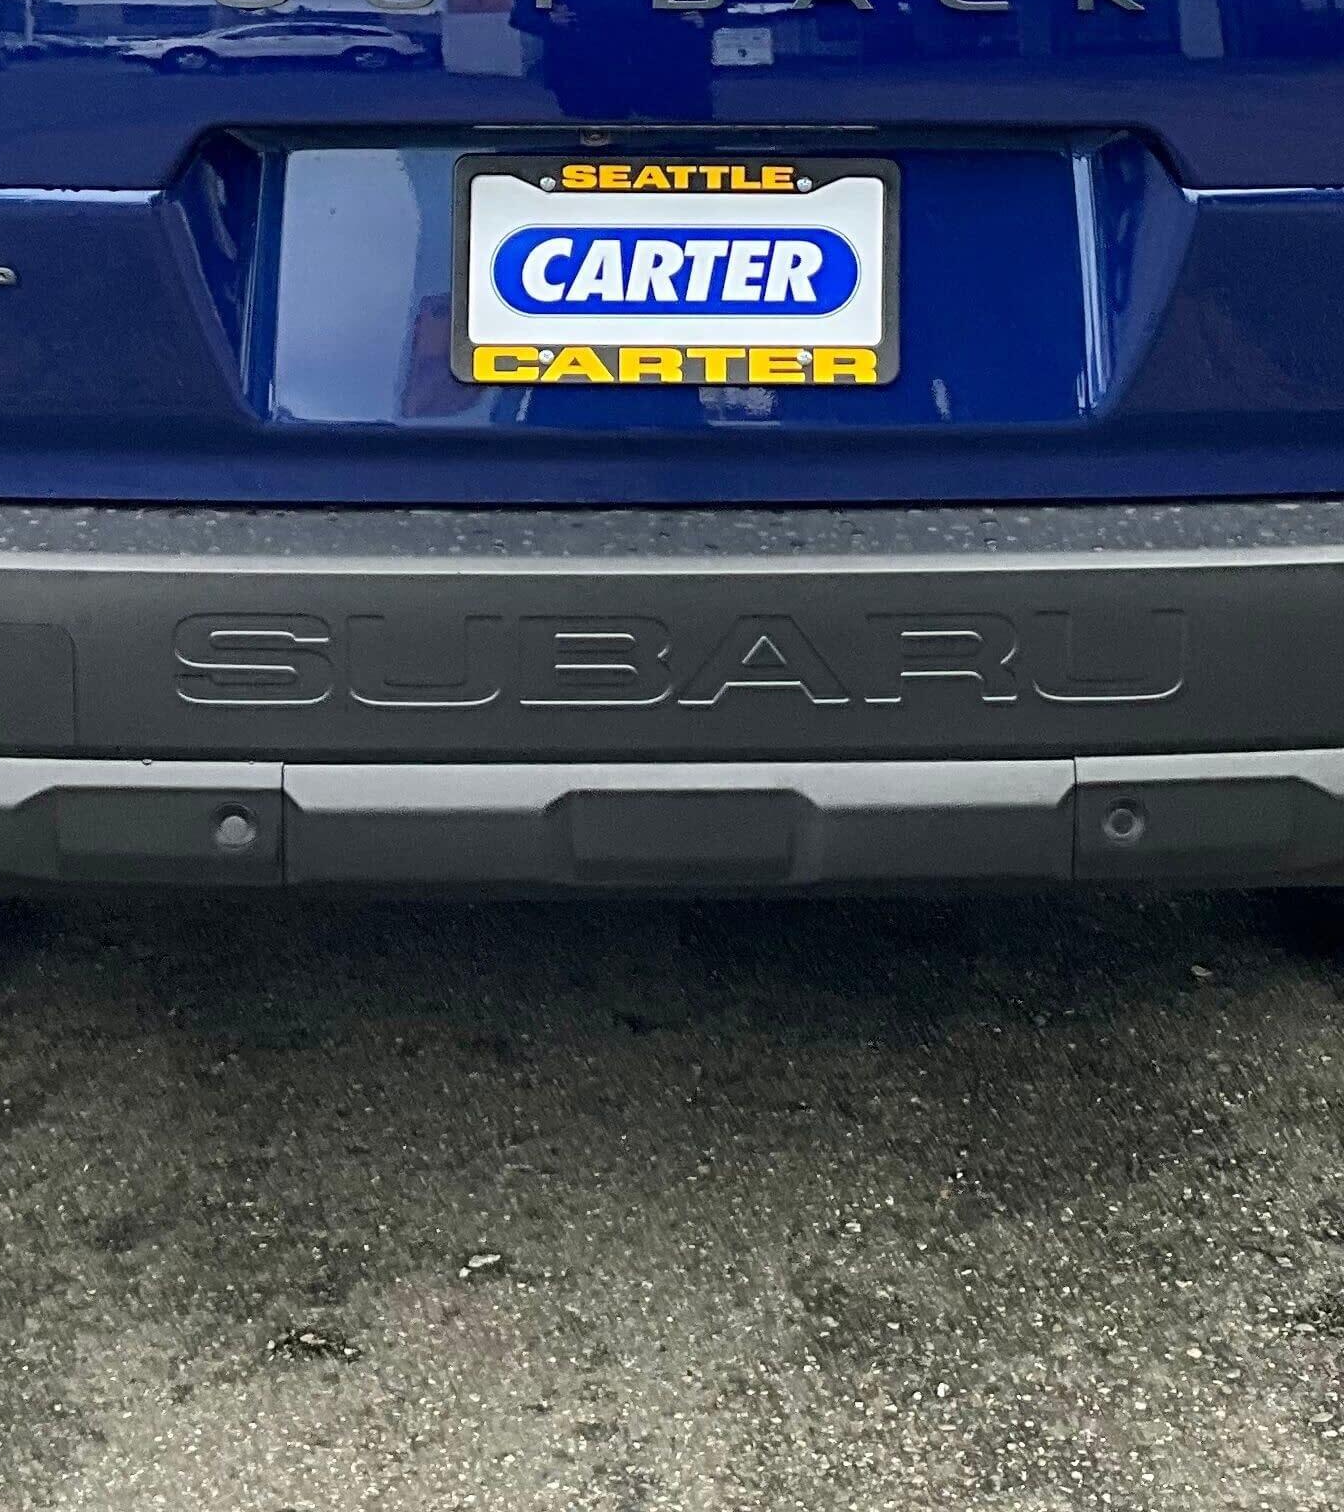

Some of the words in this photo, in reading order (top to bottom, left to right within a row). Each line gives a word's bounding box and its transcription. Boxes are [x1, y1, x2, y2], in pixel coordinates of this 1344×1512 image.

[561, 164, 795, 191] SEATTLE
[521, 237, 824, 303] CARTER
[472, 345, 879, 383] CARTER
[173, 610, 1186, 709] SUBARU
